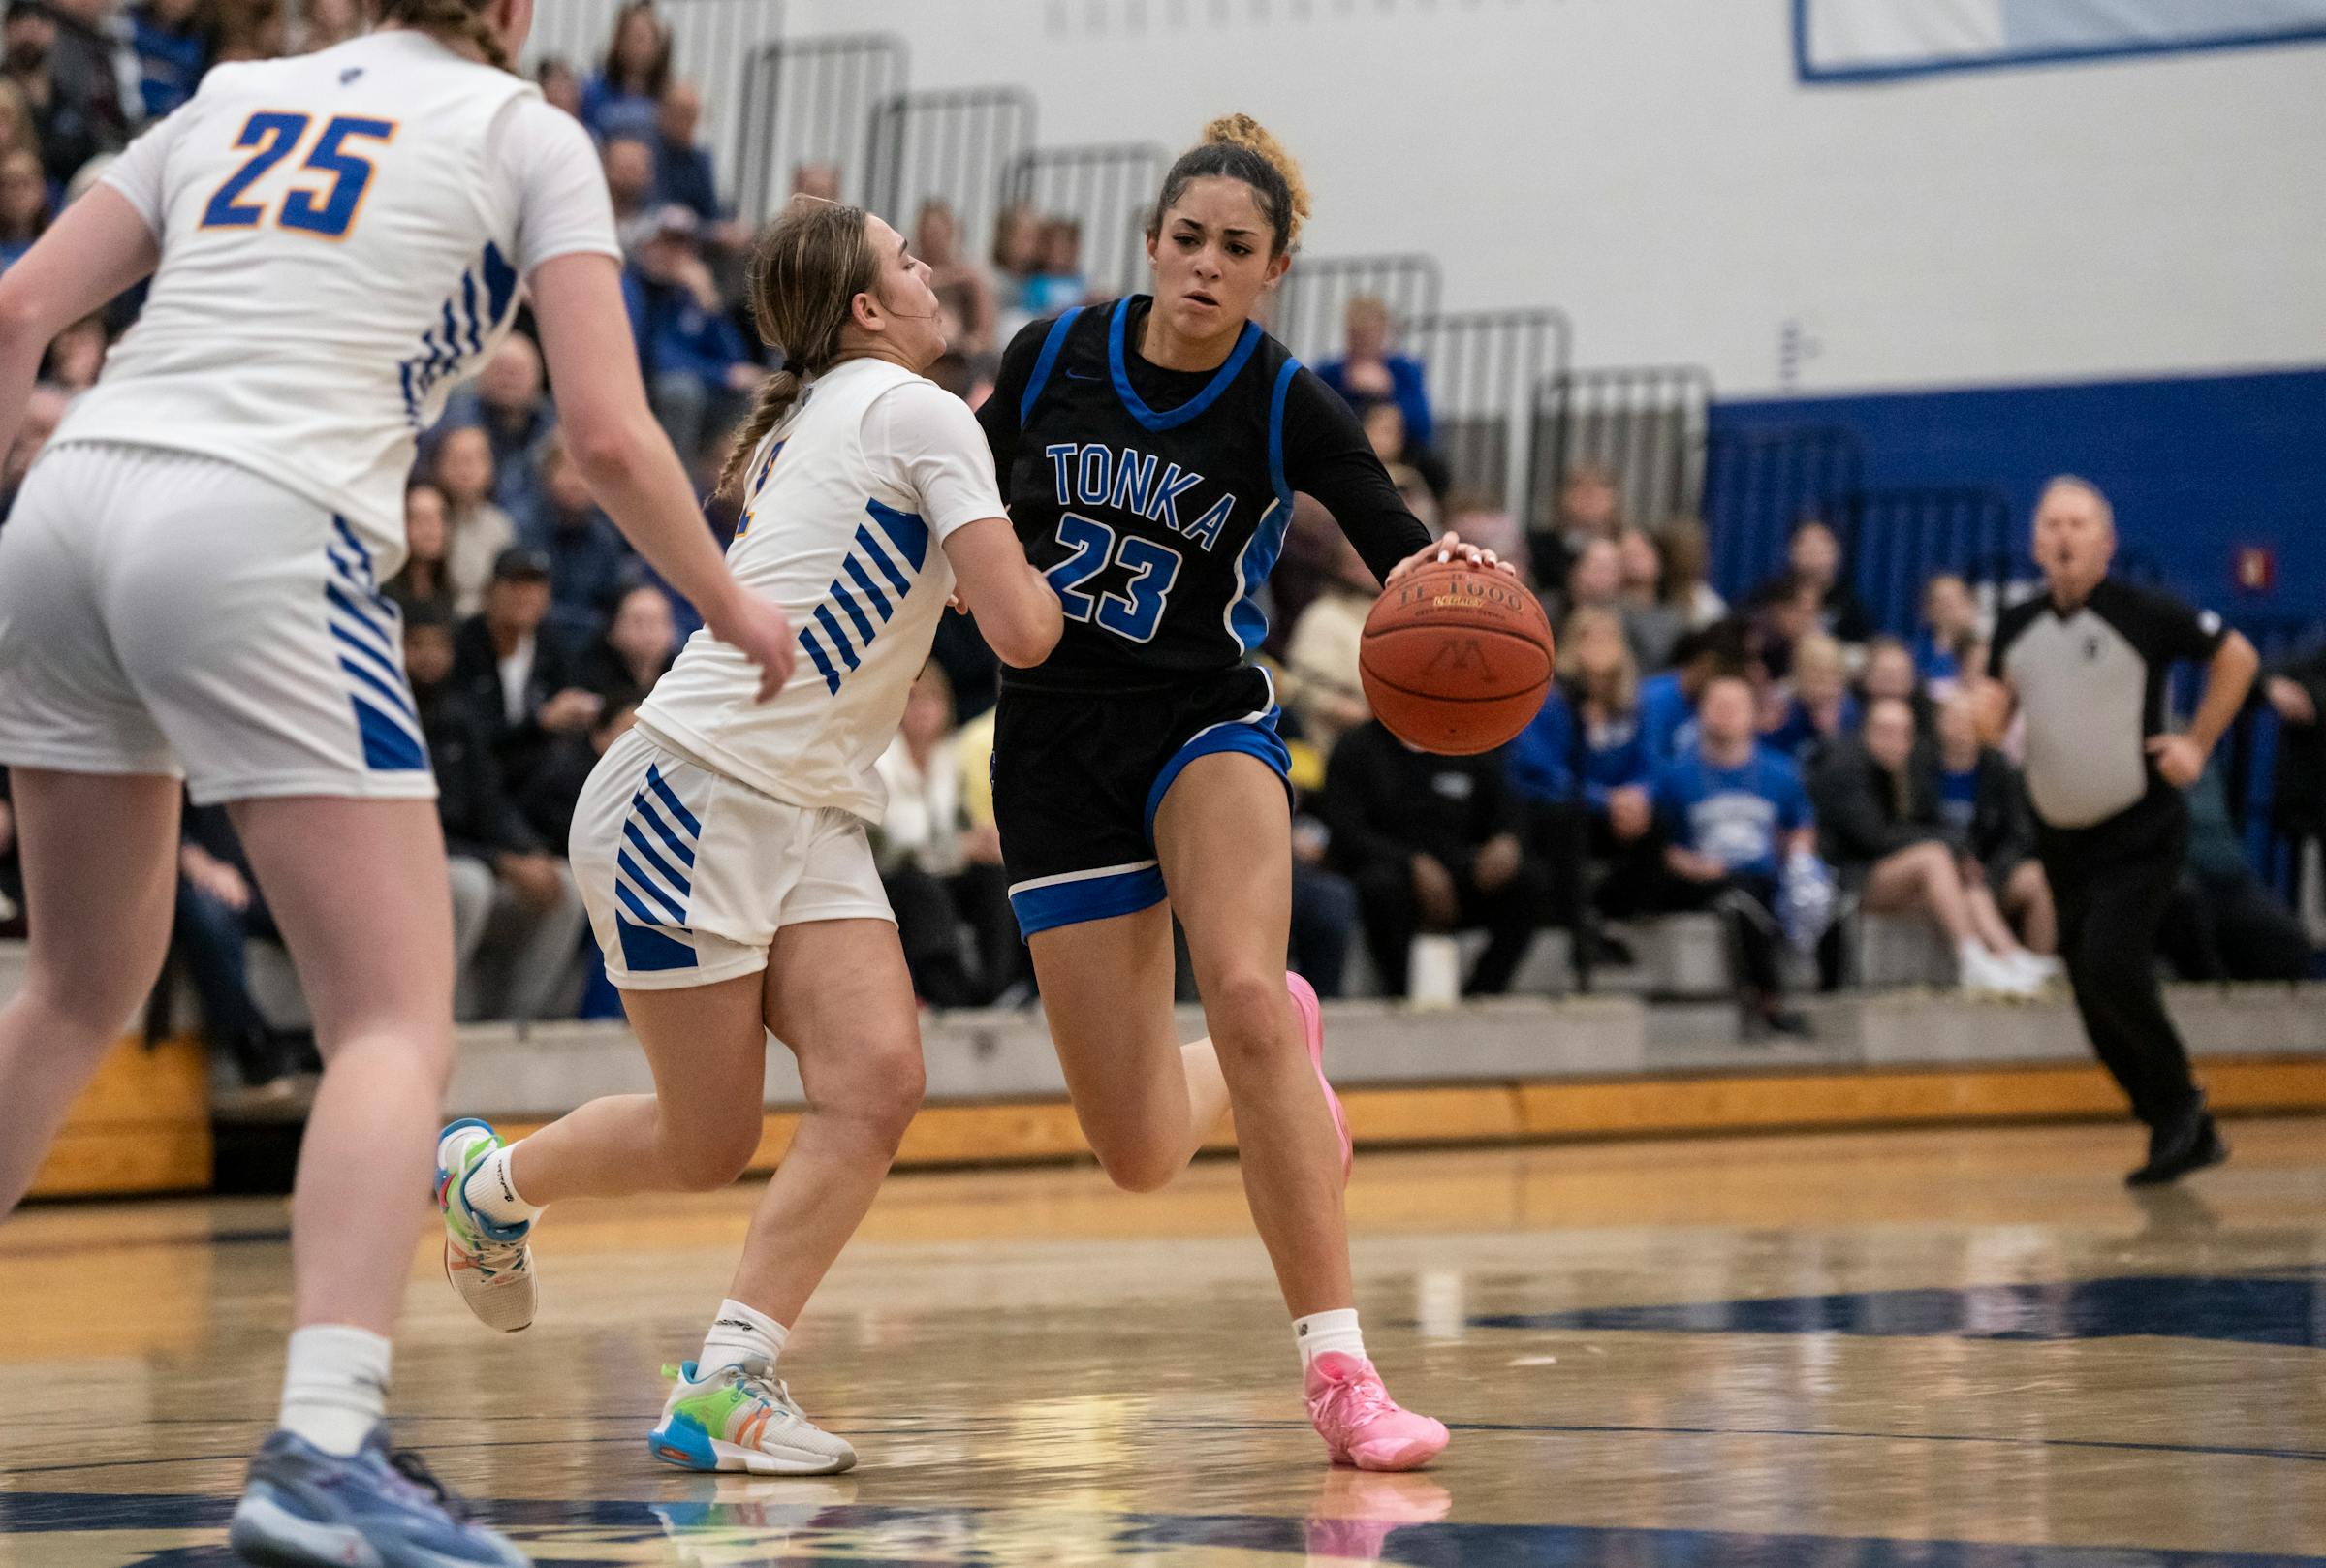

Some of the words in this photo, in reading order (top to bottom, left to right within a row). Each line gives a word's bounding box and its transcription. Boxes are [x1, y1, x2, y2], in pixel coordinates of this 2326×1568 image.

[198, 109, 398, 242] 25
[1046, 443, 1236, 552] TONKA
[1042, 512, 1183, 643] 23
